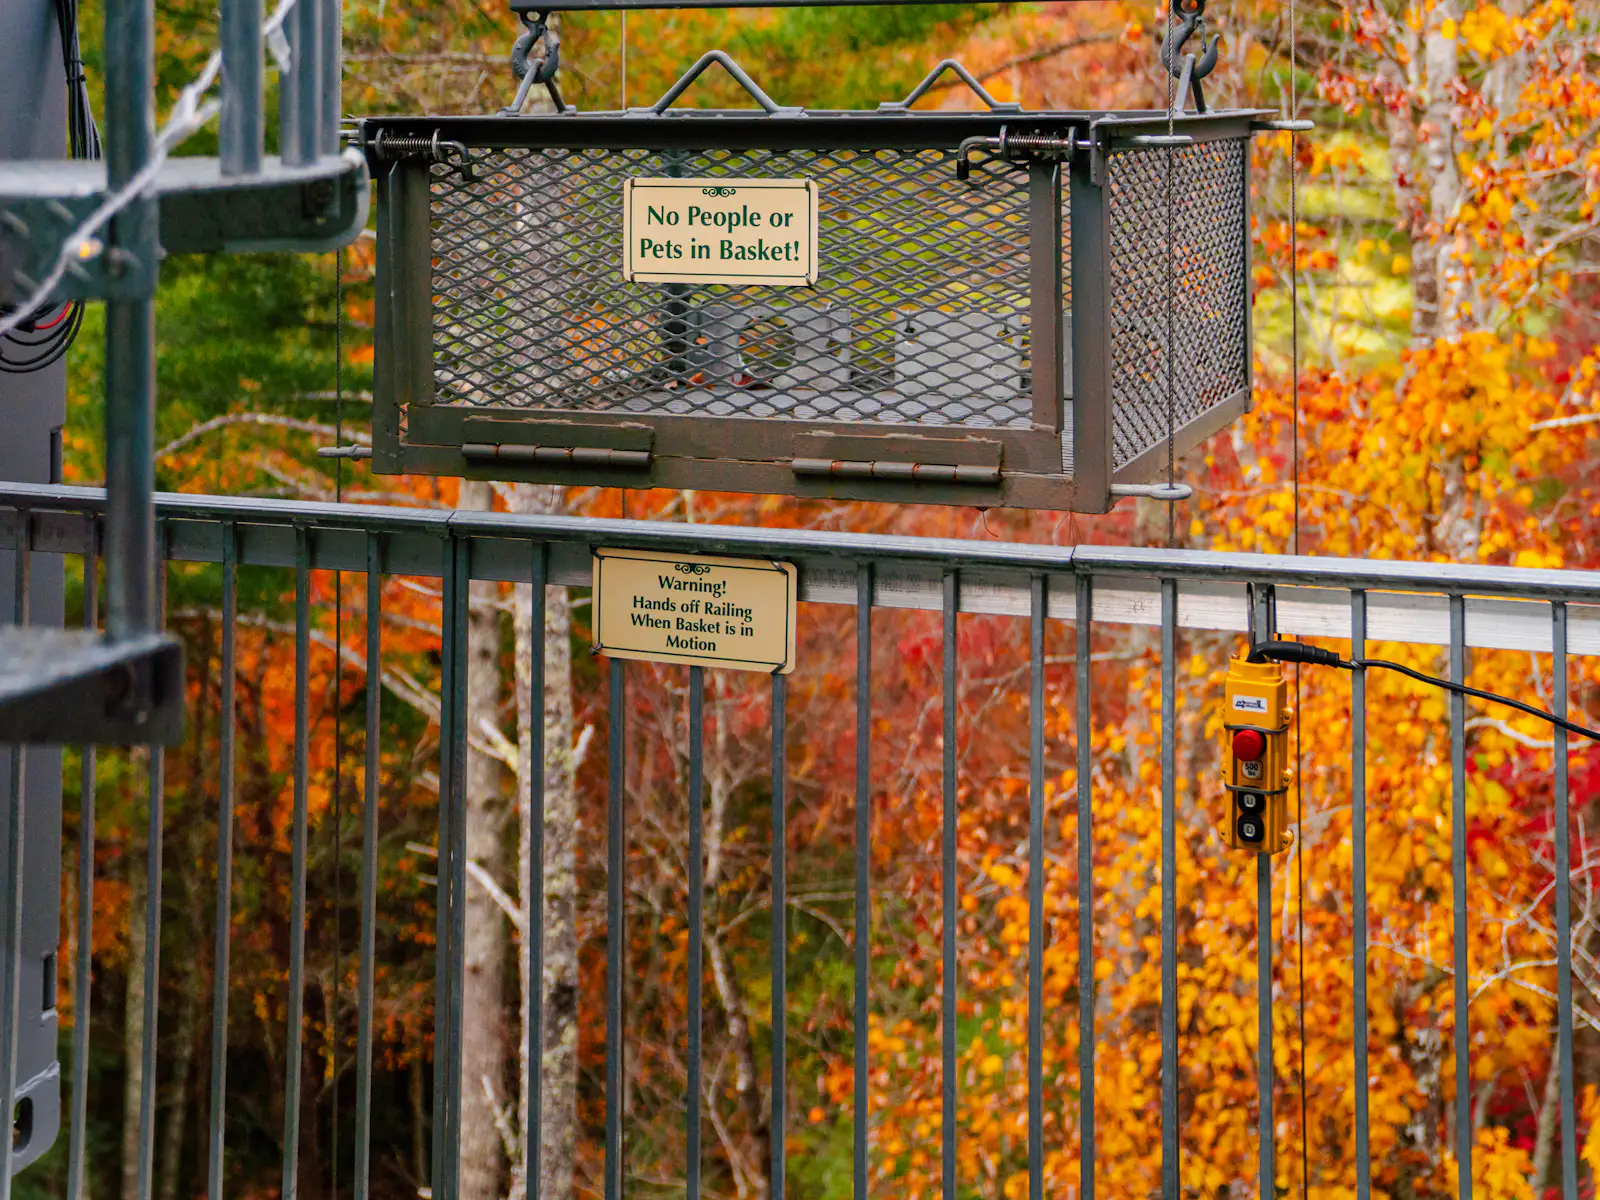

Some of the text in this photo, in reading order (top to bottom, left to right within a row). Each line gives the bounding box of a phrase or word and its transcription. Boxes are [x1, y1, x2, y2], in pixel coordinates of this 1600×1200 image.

[647, 204, 794, 234] No People or
[640, 237, 800, 262] Pets in Basket!
[658, 575, 727, 598] Warning!
[633, 595, 753, 622] Hands off Railing
[631, 613, 754, 637] When Basket is in
[665, 634, 716, 651] Motion
[1245, 762, 1259, 771] 500
